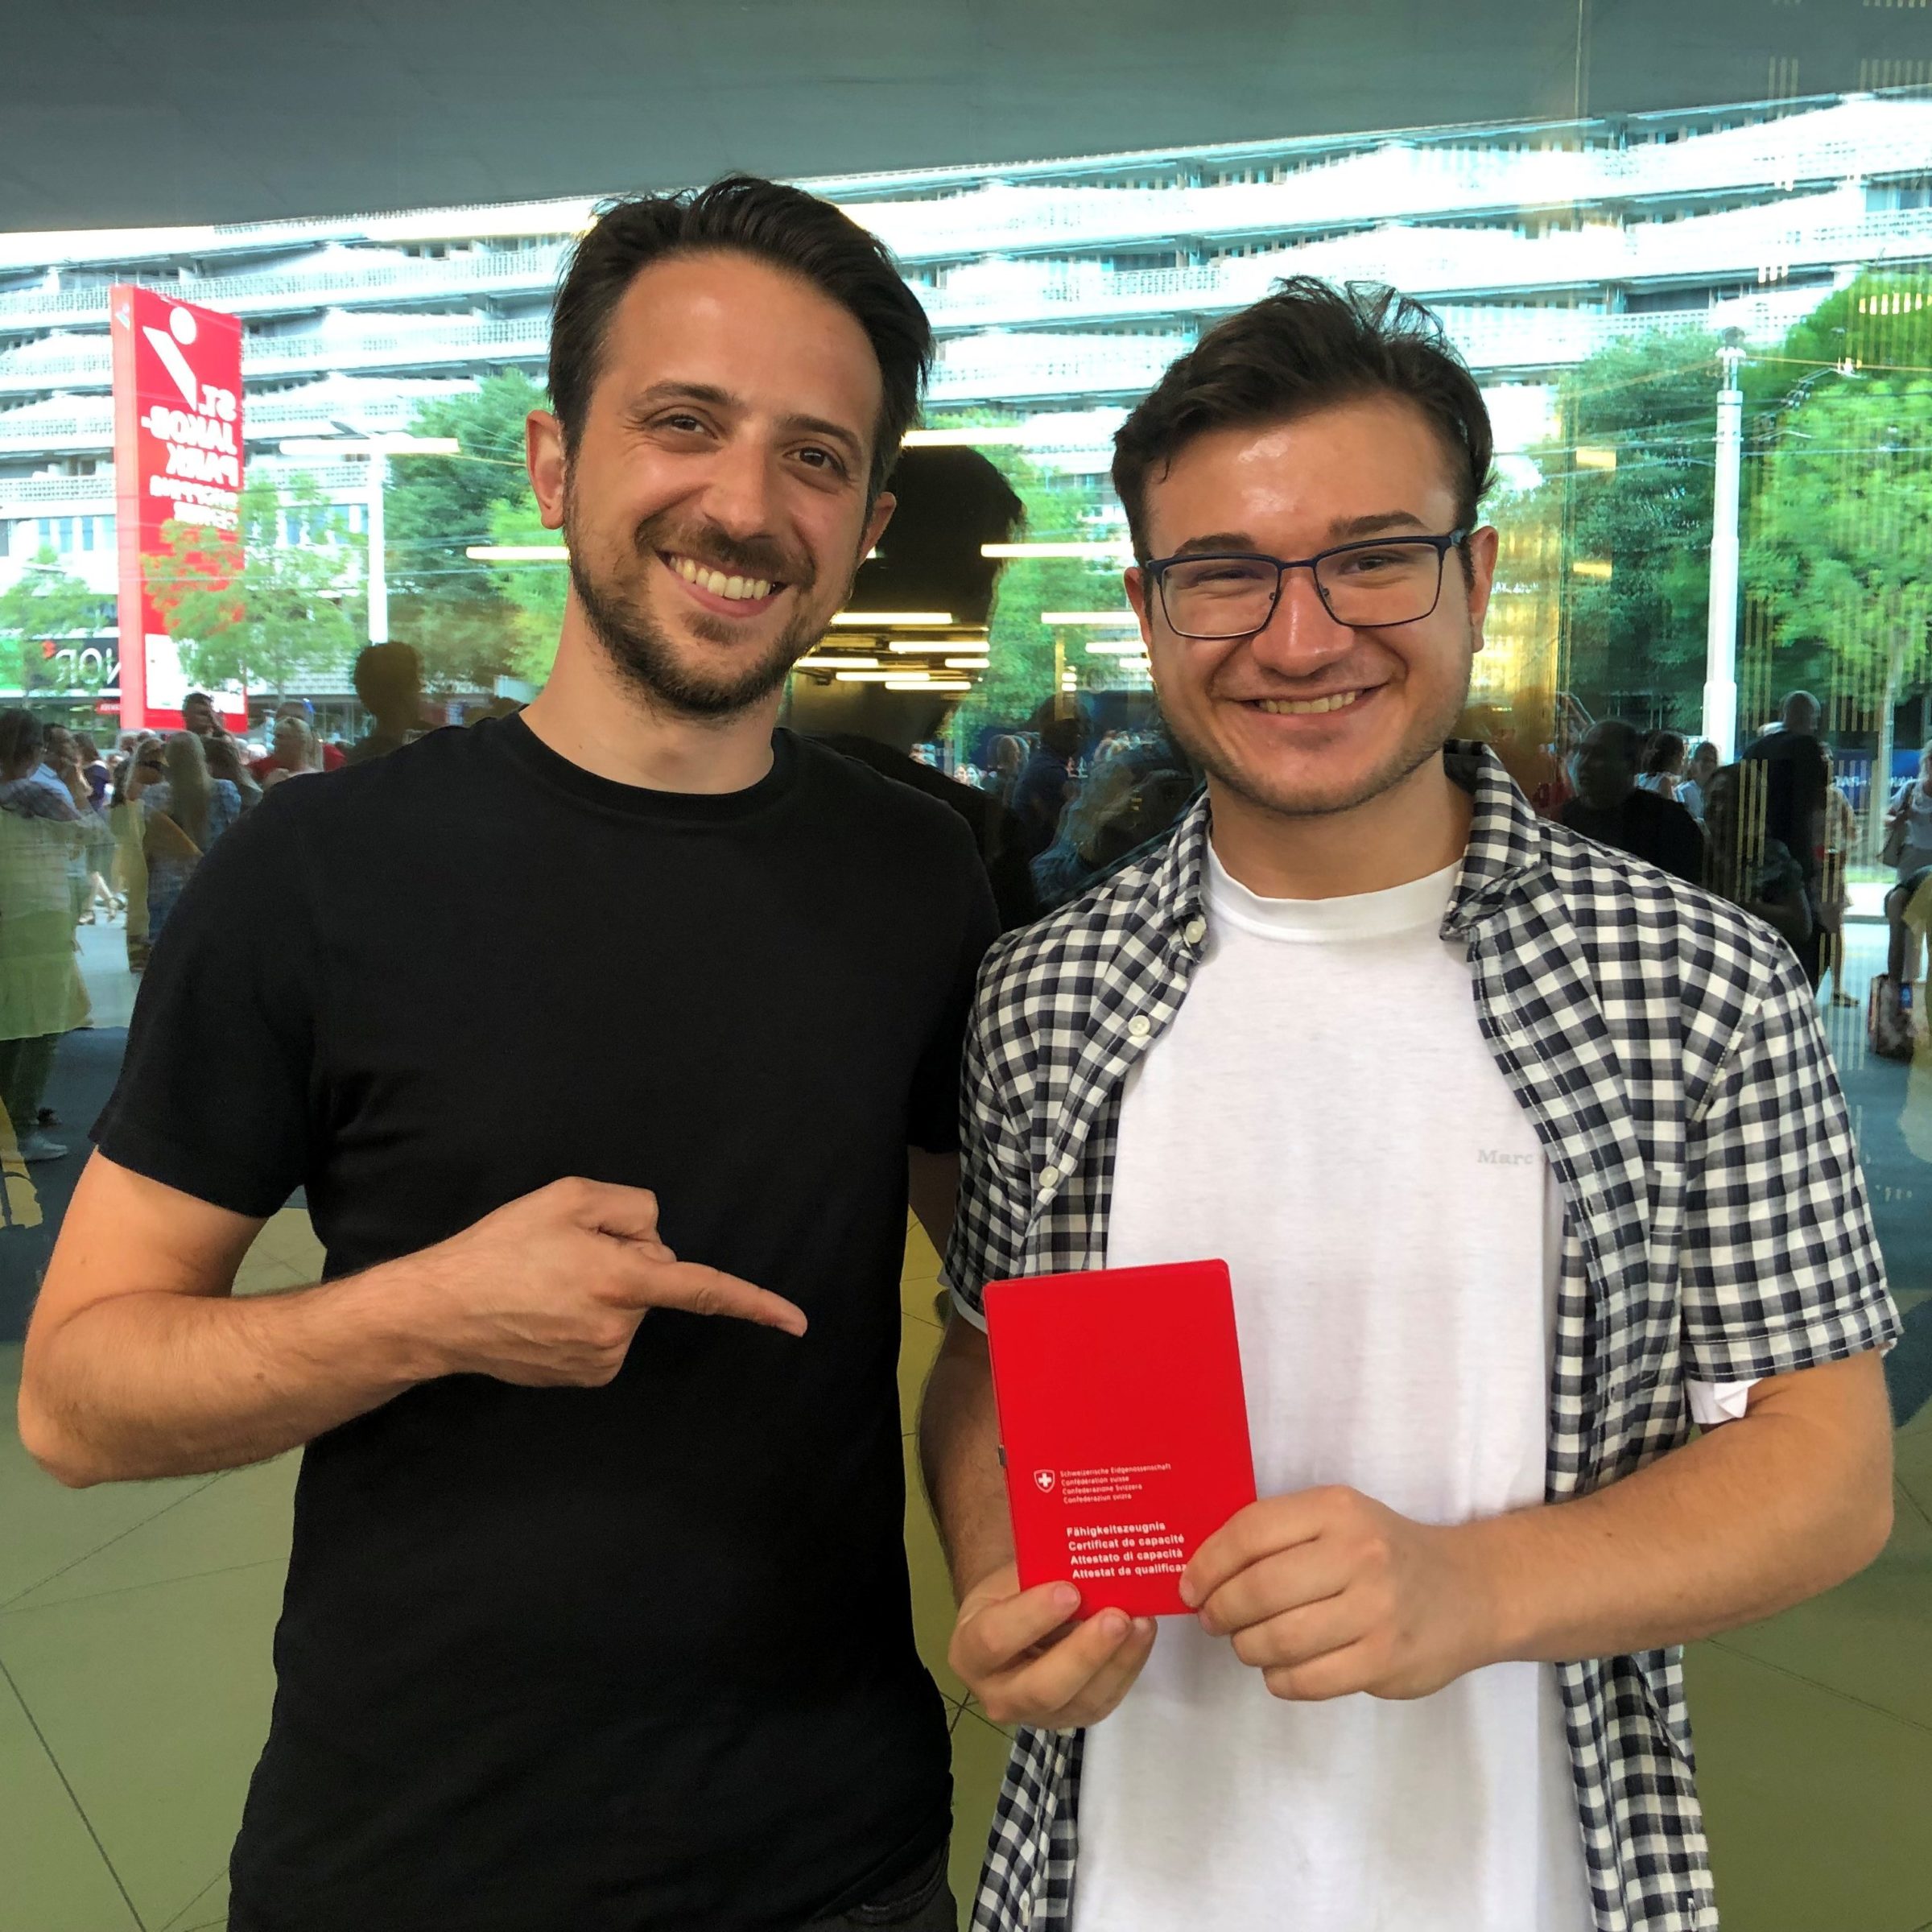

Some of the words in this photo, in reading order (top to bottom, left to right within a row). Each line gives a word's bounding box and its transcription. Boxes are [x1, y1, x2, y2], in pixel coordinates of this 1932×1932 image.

[1476, 1149, 1534, 1165] Marc
[1059, 1467, 1109, 1478] Schweizerische
[1110, 1463, 1171, 1475] Eidgenossenschaft
[1109, 1476, 1129, 1484] suisse
[1062, 1485, 1114, 1495] Confederazione
[1115, 1484, 1143, 1492] Svizzera
[1063, 1495, 1111, 1505] Confederaziun
[1066, 1521, 1166, 1538] Fähigkeitszeugnis
[1068, 1538, 1119, 1552] Certificat
[1121, 1538, 1135, 1548] de
[1138, 1534, 1185, 1547] capacité
[1070, 1553, 1121, 1566] Attestato
[1123, 1550, 1133, 1562] di
[1137, 1548, 1183, 1562] capacità
[1072, 1567, 1116, 1579] Attestat
[1117, 1566, 1132, 1576] da
[1135, 1563, 1187, 1577] qualificaz
